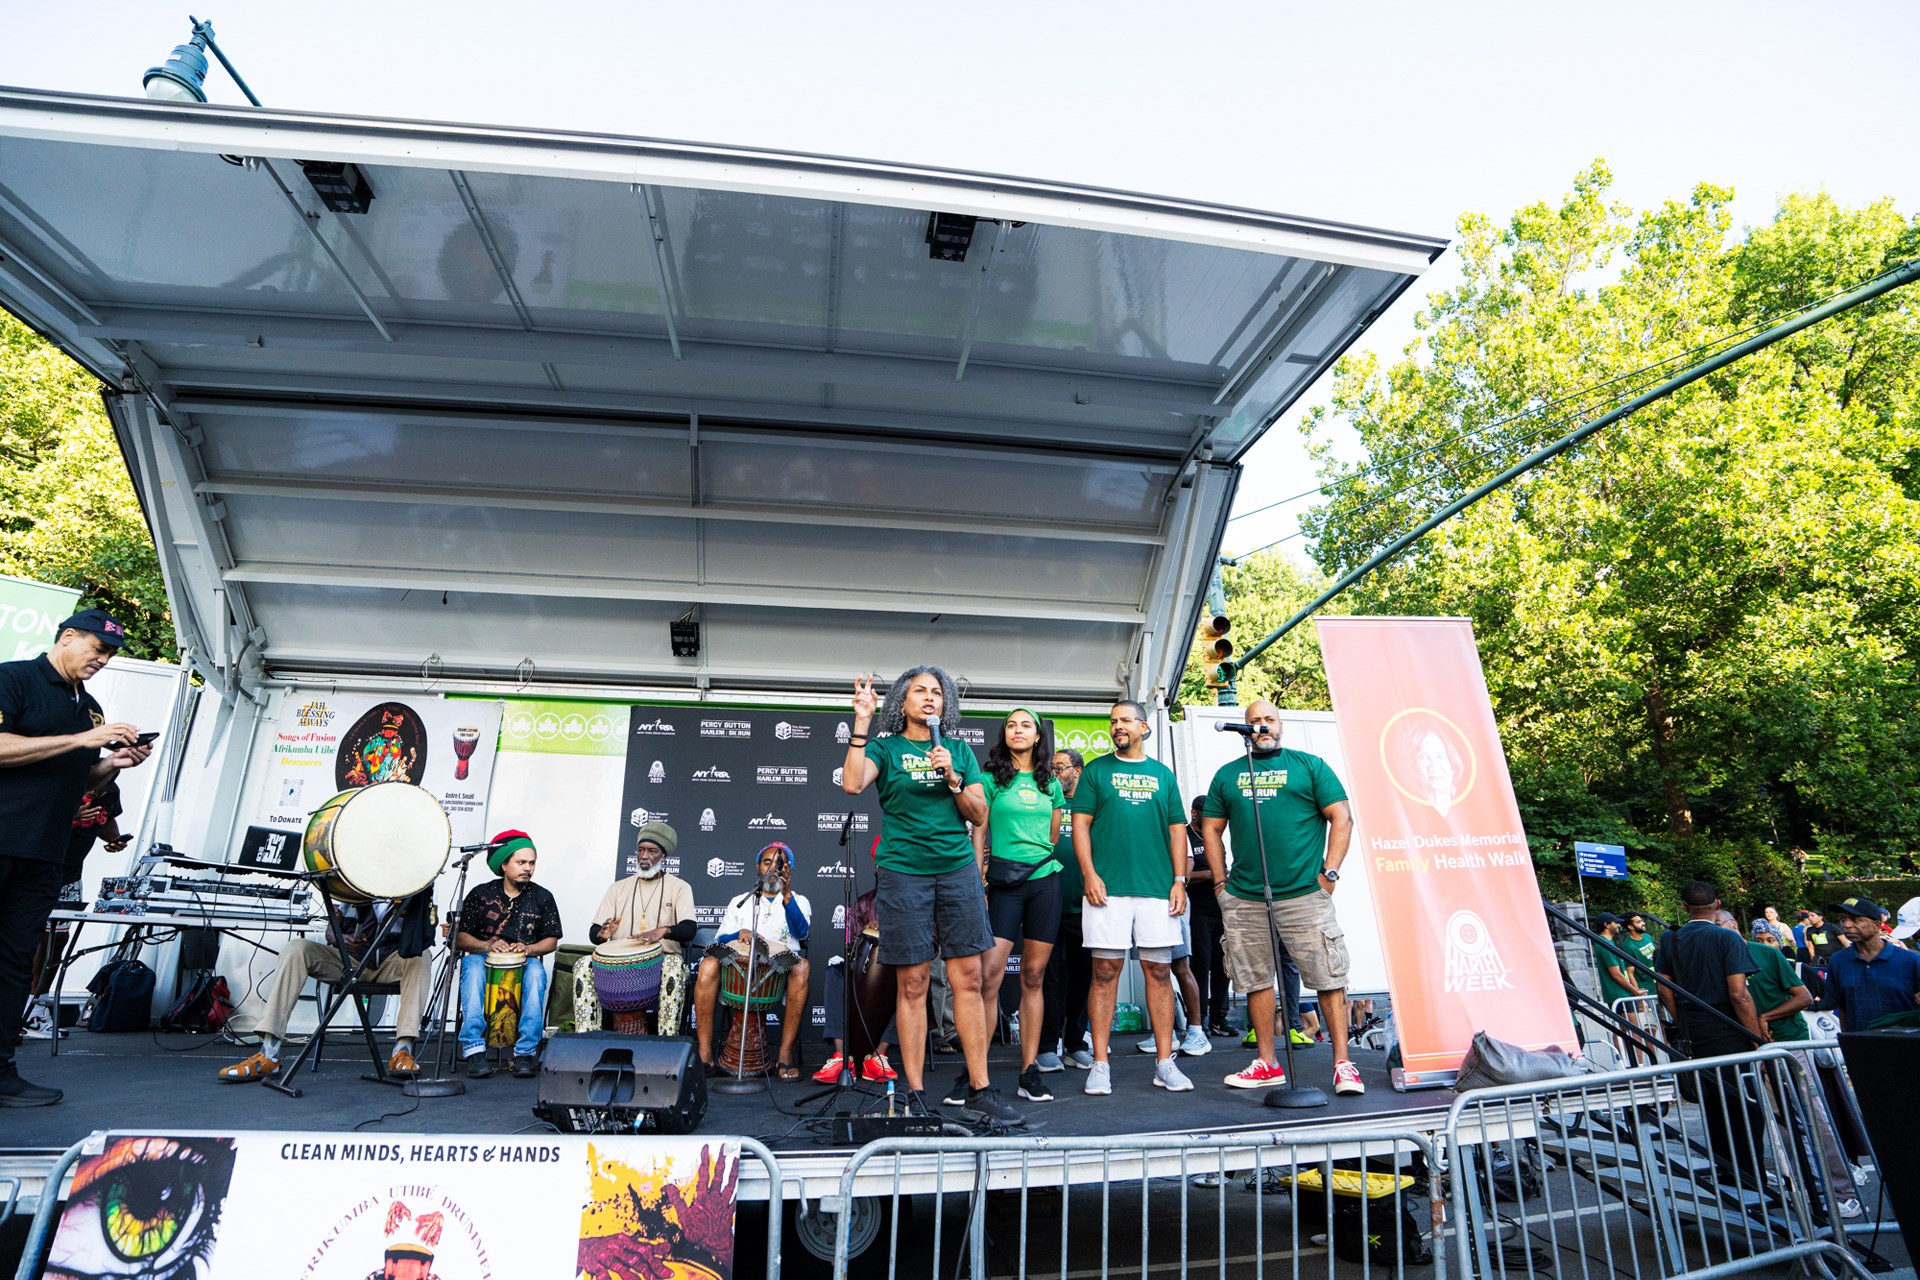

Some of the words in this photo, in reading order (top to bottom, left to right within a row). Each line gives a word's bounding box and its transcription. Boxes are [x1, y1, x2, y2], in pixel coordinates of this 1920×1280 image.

[296, 708, 335, 719] BLESSING
[278, 733, 300, 742] Songs
[310, 733, 336, 742] Fusion
[926, 770, 944, 779] RU
[1112, 778, 1159, 790] HARLEM
[1119, 790, 1131, 798] 5K
[1132, 791, 1152, 799] RUN
[1371, 836, 1410, 850] Hazel
[1413, 834, 1457, 848] Dukes
[1459, 832, 1522, 847] Memorial
[1375, 857, 1430, 874] Family
[1434, 853, 1485, 869] Health
[1488, 851, 1527, 867] Walk
[1444, 974, 1515, 993] WEEK
[281, 1143, 336, 1160] CLEAN
[341, 1144, 404, 1164] MINDS,
[410, 1145, 478, 1162] HEARTS
[483, 1146, 496, 1162] &
[500, 1146, 560, 1163] HANDS
[390, 1184, 438, 1201] UTIBÉ
